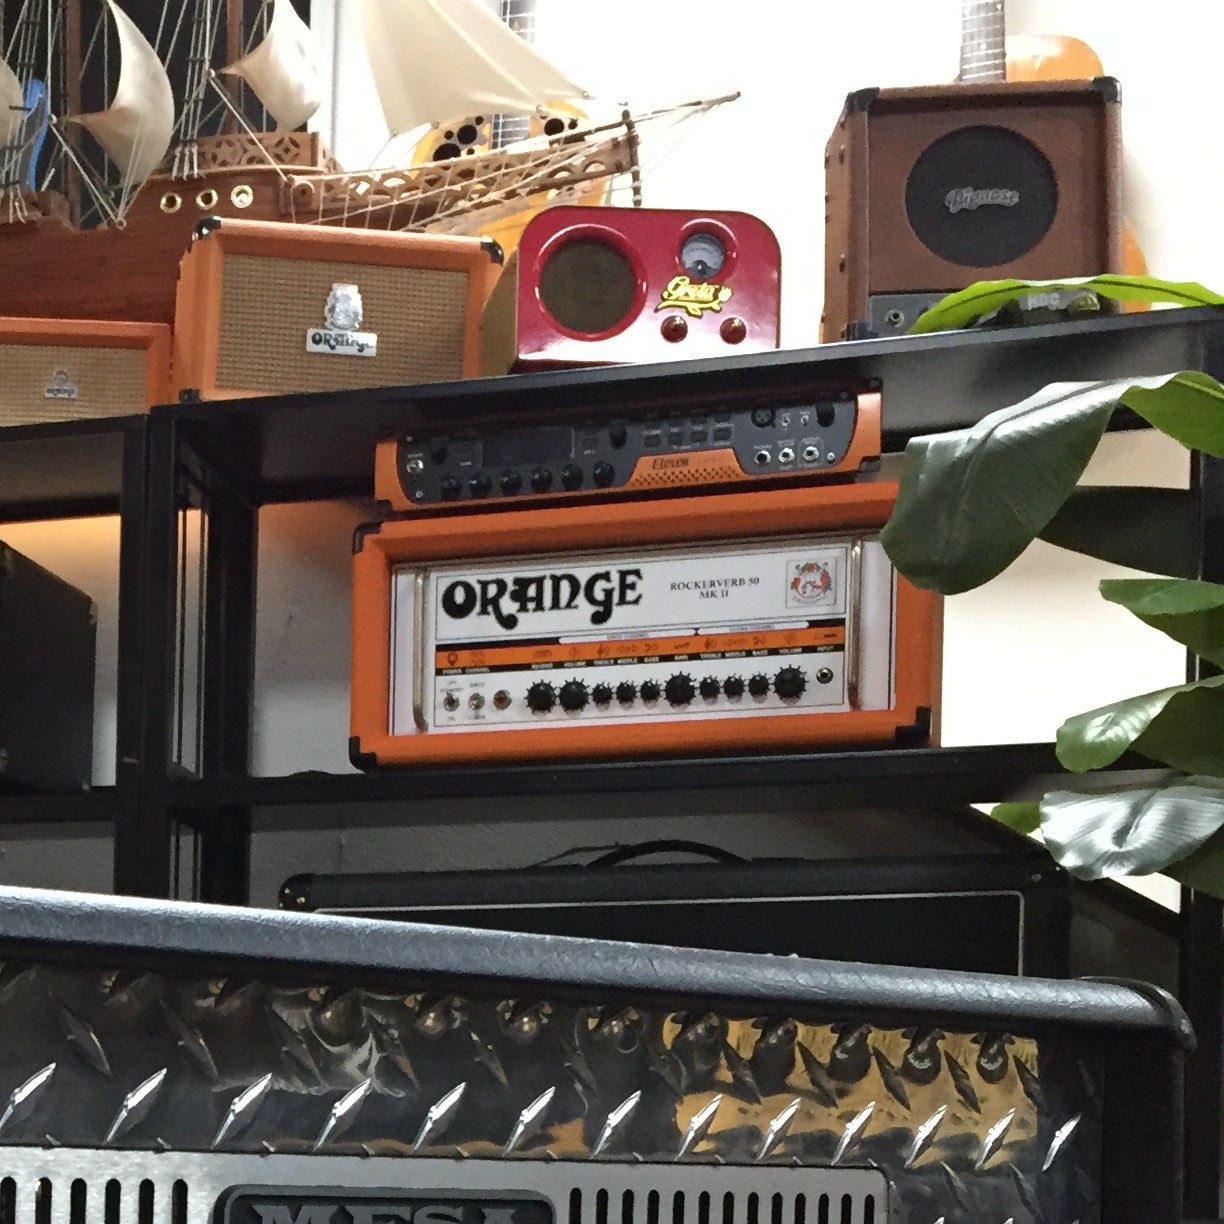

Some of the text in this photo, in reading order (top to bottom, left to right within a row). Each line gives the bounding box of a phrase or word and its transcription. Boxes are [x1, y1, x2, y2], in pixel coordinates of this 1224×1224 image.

[670, 576, 761, 592] ROCKERVERB 50
[441, 568, 644, 630] ORANGE
[699, 589, 719, 600] MK
